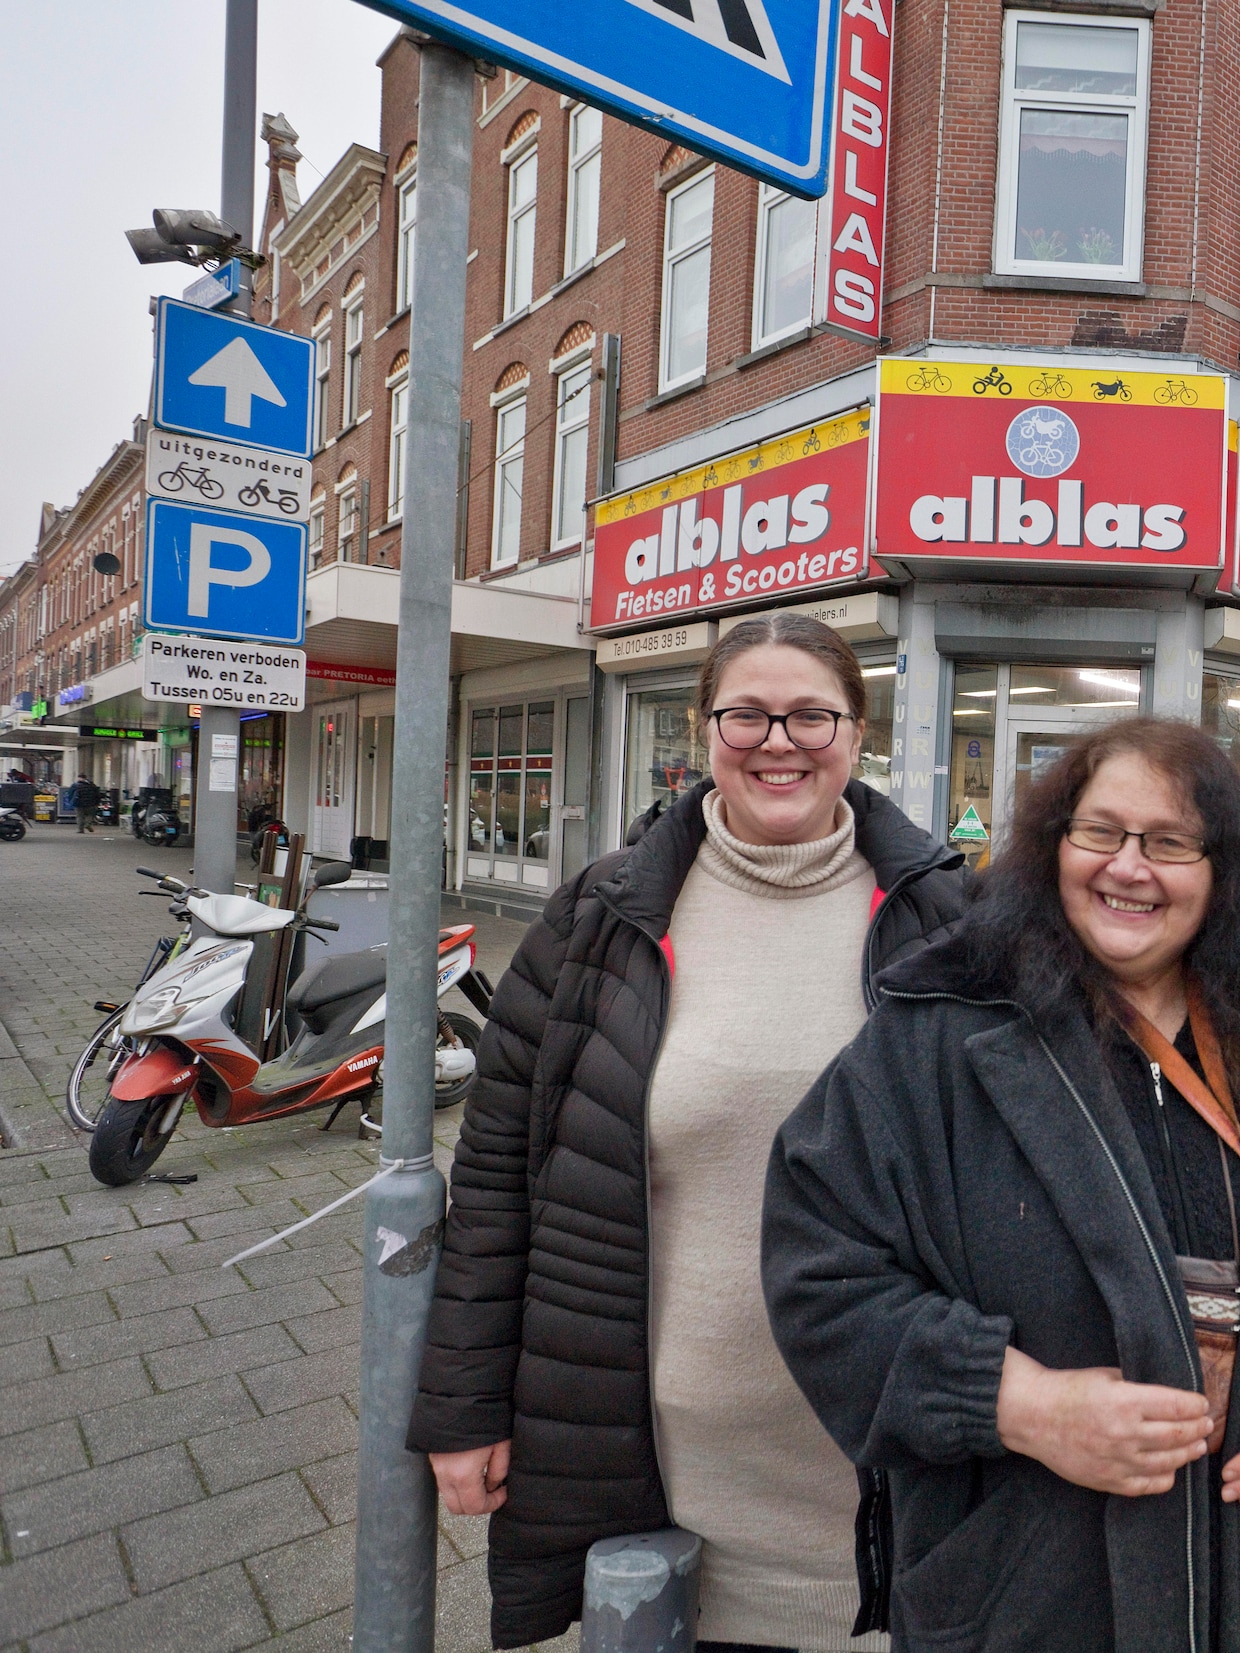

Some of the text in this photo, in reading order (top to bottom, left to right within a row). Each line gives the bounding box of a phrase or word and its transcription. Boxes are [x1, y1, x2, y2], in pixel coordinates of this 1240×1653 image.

[833, 0, 890, 323] ALBLAS
[159, 439, 303, 478] uitgezonderd
[909, 475, 1187, 552] alblas
[625, 483, 831, 586] alblas
[188, 522, 271, 618] P
[615, 546, 858, 620] Fietsen & Scooters
[151, 641, 299, 669] Parkeren verboden
[661, 632, 674, 648] 39
[675, 630, 687, 646] 59
[187, 664, 267, 685] Wo. en Za.
[323, 669, 374, 682] PRETORIA
[151, 681, 298, 706] Tussen 05u en 22u
[347, 1055, 379, 1073] YAMAHA
